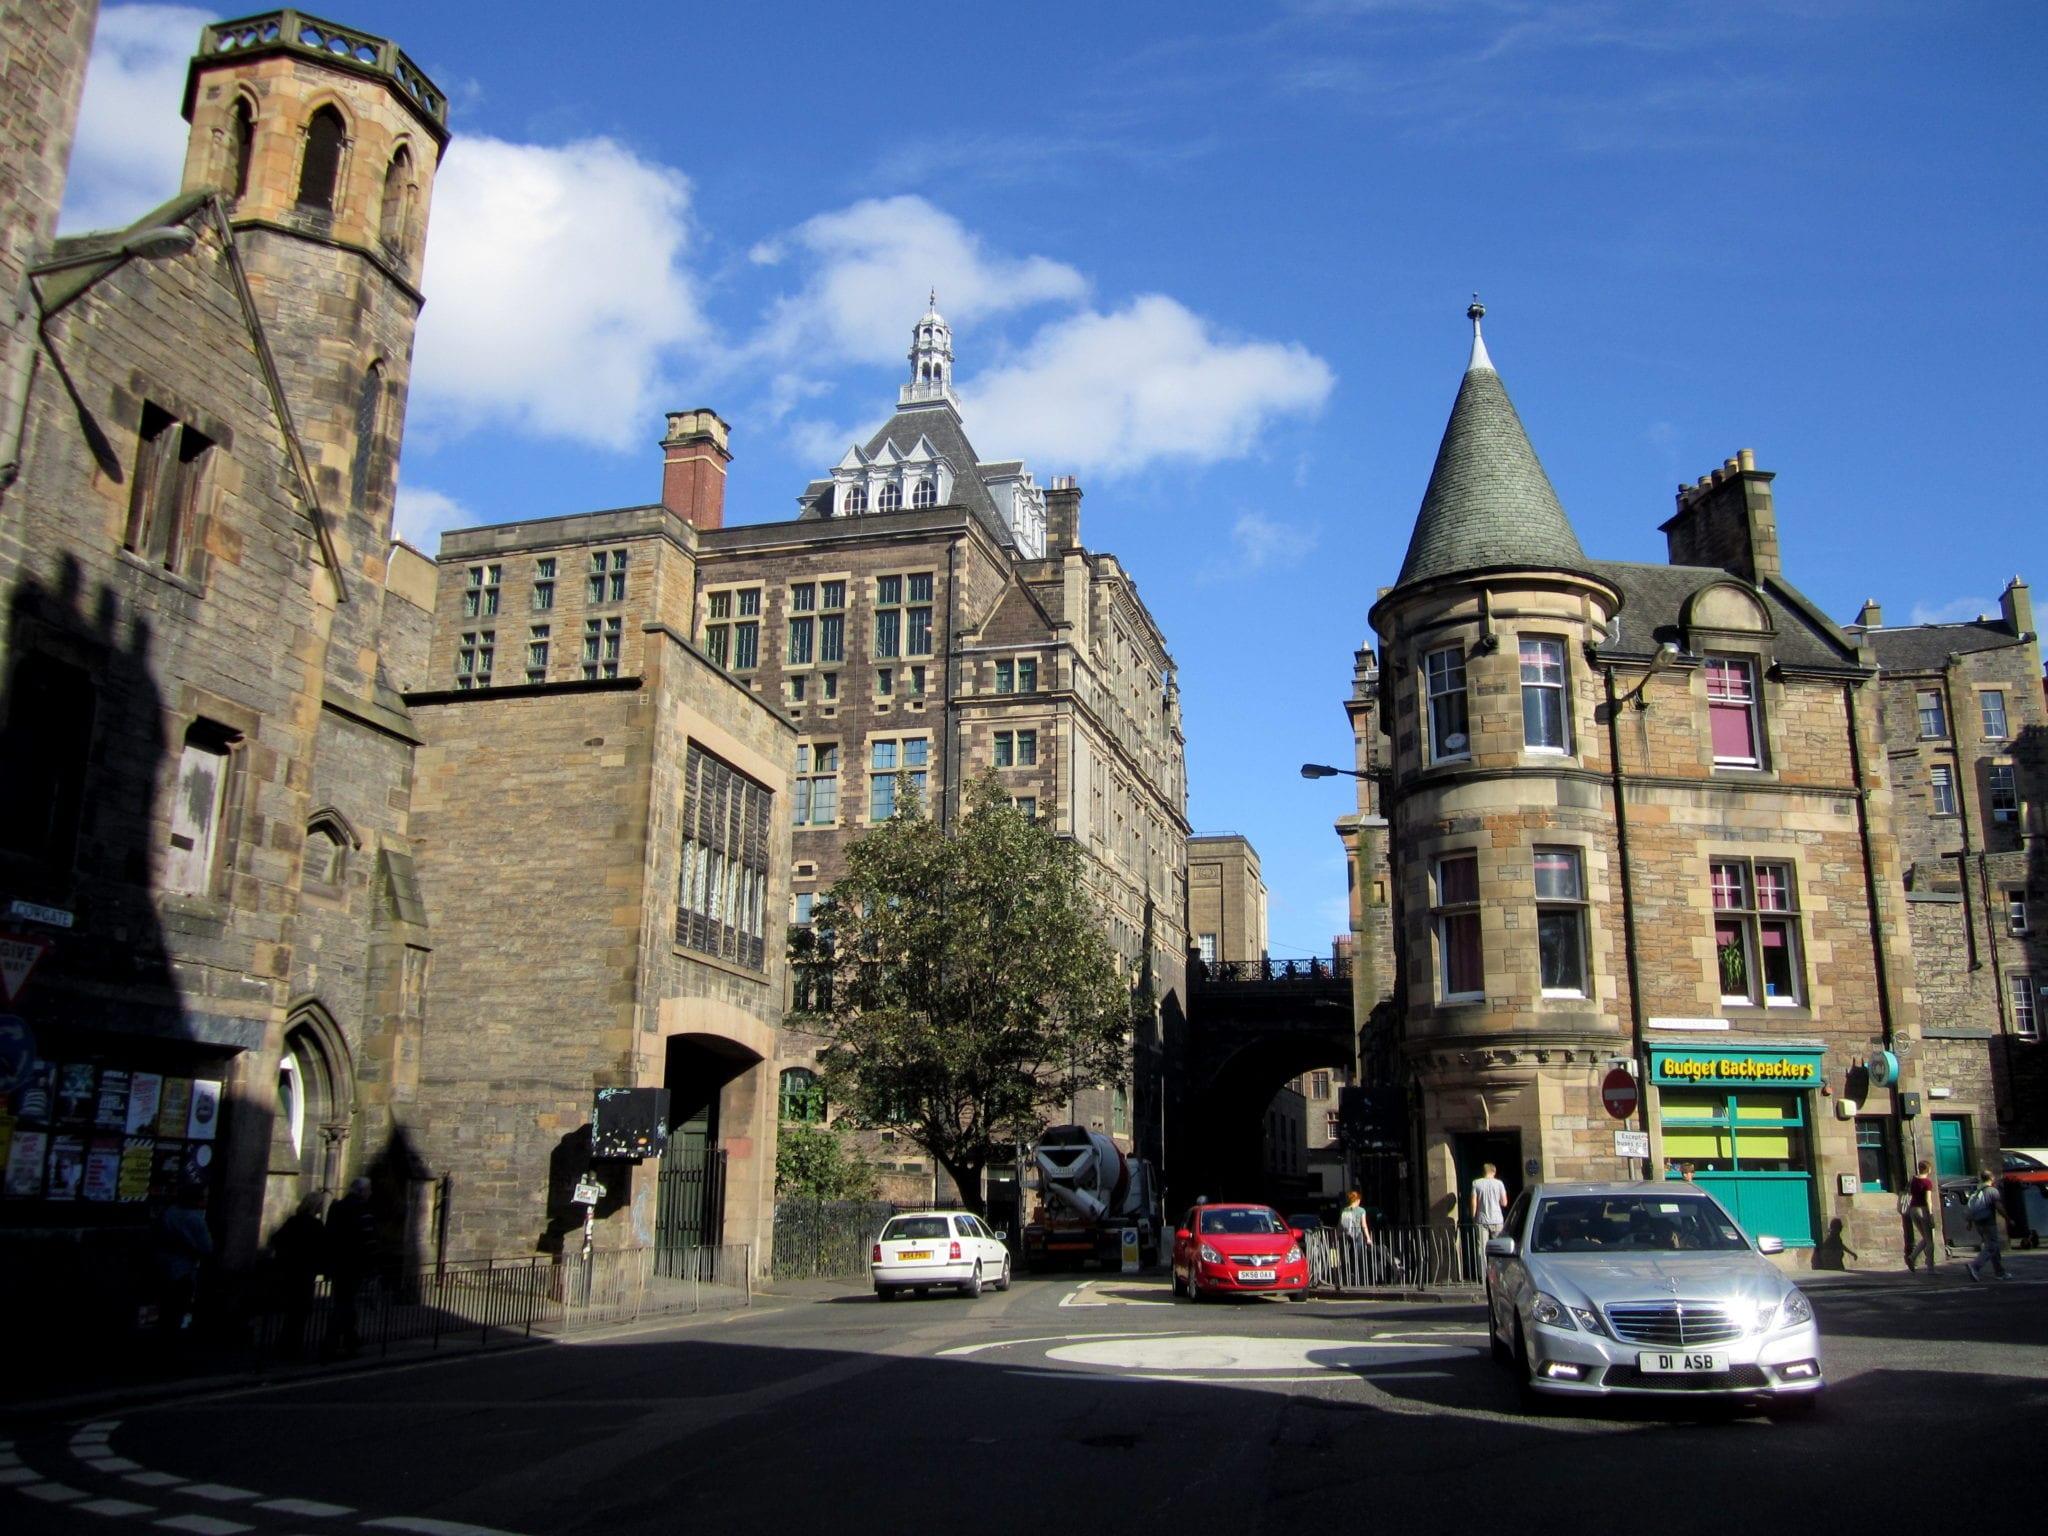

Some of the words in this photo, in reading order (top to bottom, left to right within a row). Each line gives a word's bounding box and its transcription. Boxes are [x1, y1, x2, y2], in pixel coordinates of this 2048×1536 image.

[16, 903, 70, 926] COWGATE
[0, 942, 35, 962] GIVE
[4, 960, 27, 973] WAY
[1664, 1058, 1717, 1080] Budget
[1720, 1058, 1814, 1078] Backpackers
[1621, 1133, 1643, 1141] Except
[1684, 1354, 1714, 1370] ASB
